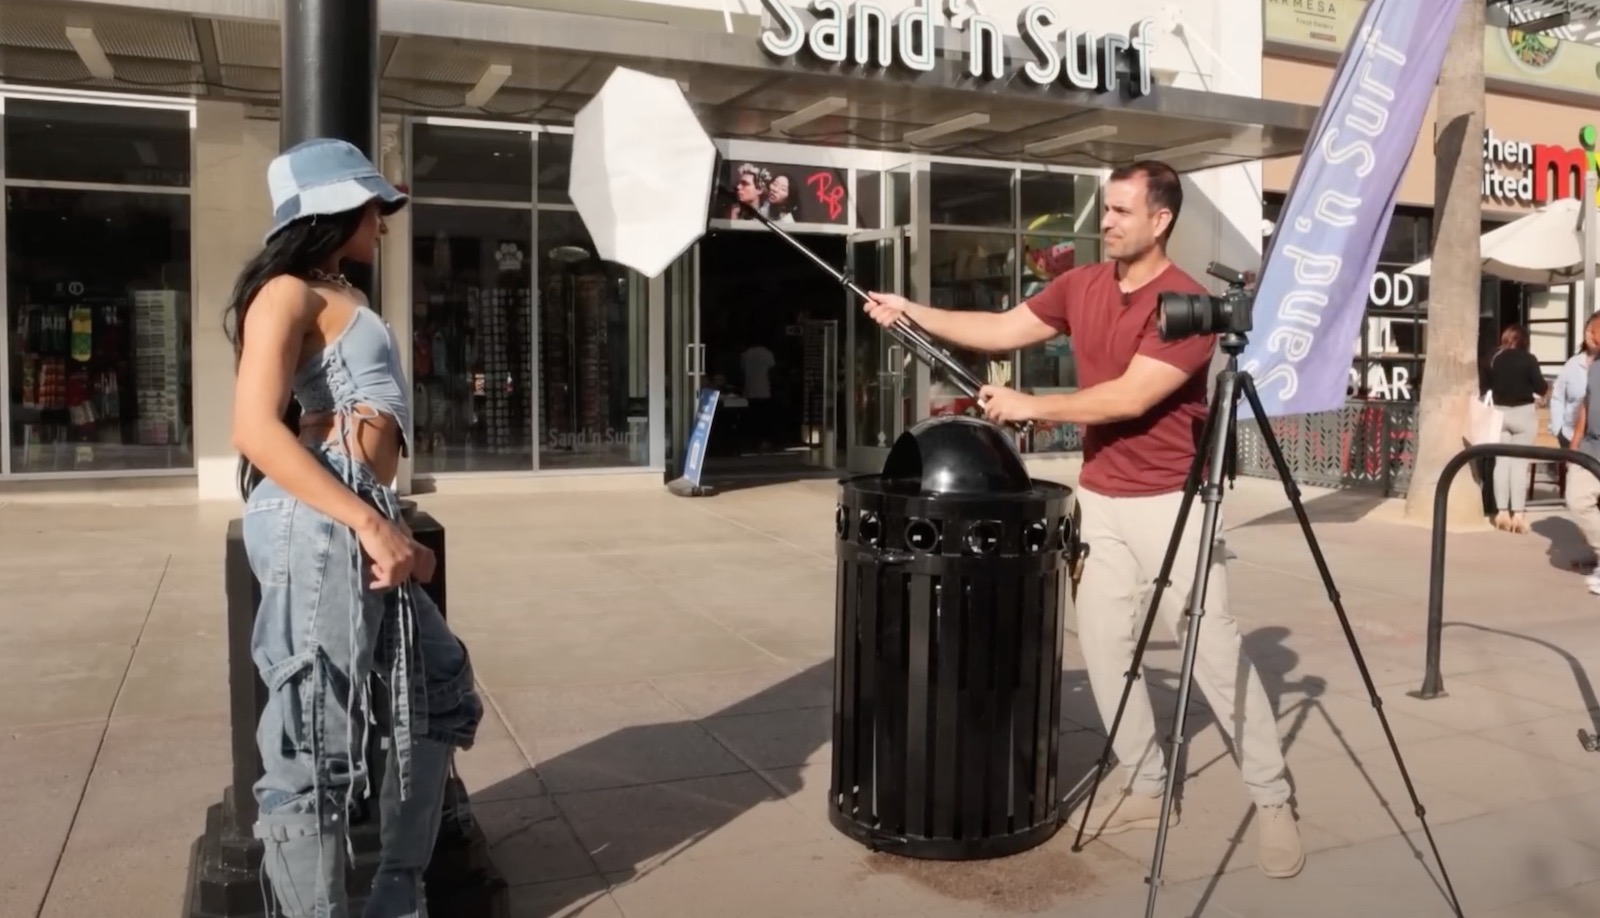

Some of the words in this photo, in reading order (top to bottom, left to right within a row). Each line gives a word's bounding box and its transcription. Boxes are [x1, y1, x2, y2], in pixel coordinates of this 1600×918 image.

[1269, 0, 1336, 14] MESA
[762, 0, 935, 71] Sand
[1024, 3, 1154, 96] Surf
[1481, 163, 1533, 201] ited
[1242, 244, 1342, 401] Sand
[1322, 25, 1407, 178] Surf
[549, 428, 586, 447] Sand
[605, 427, 639, 446] Surf
